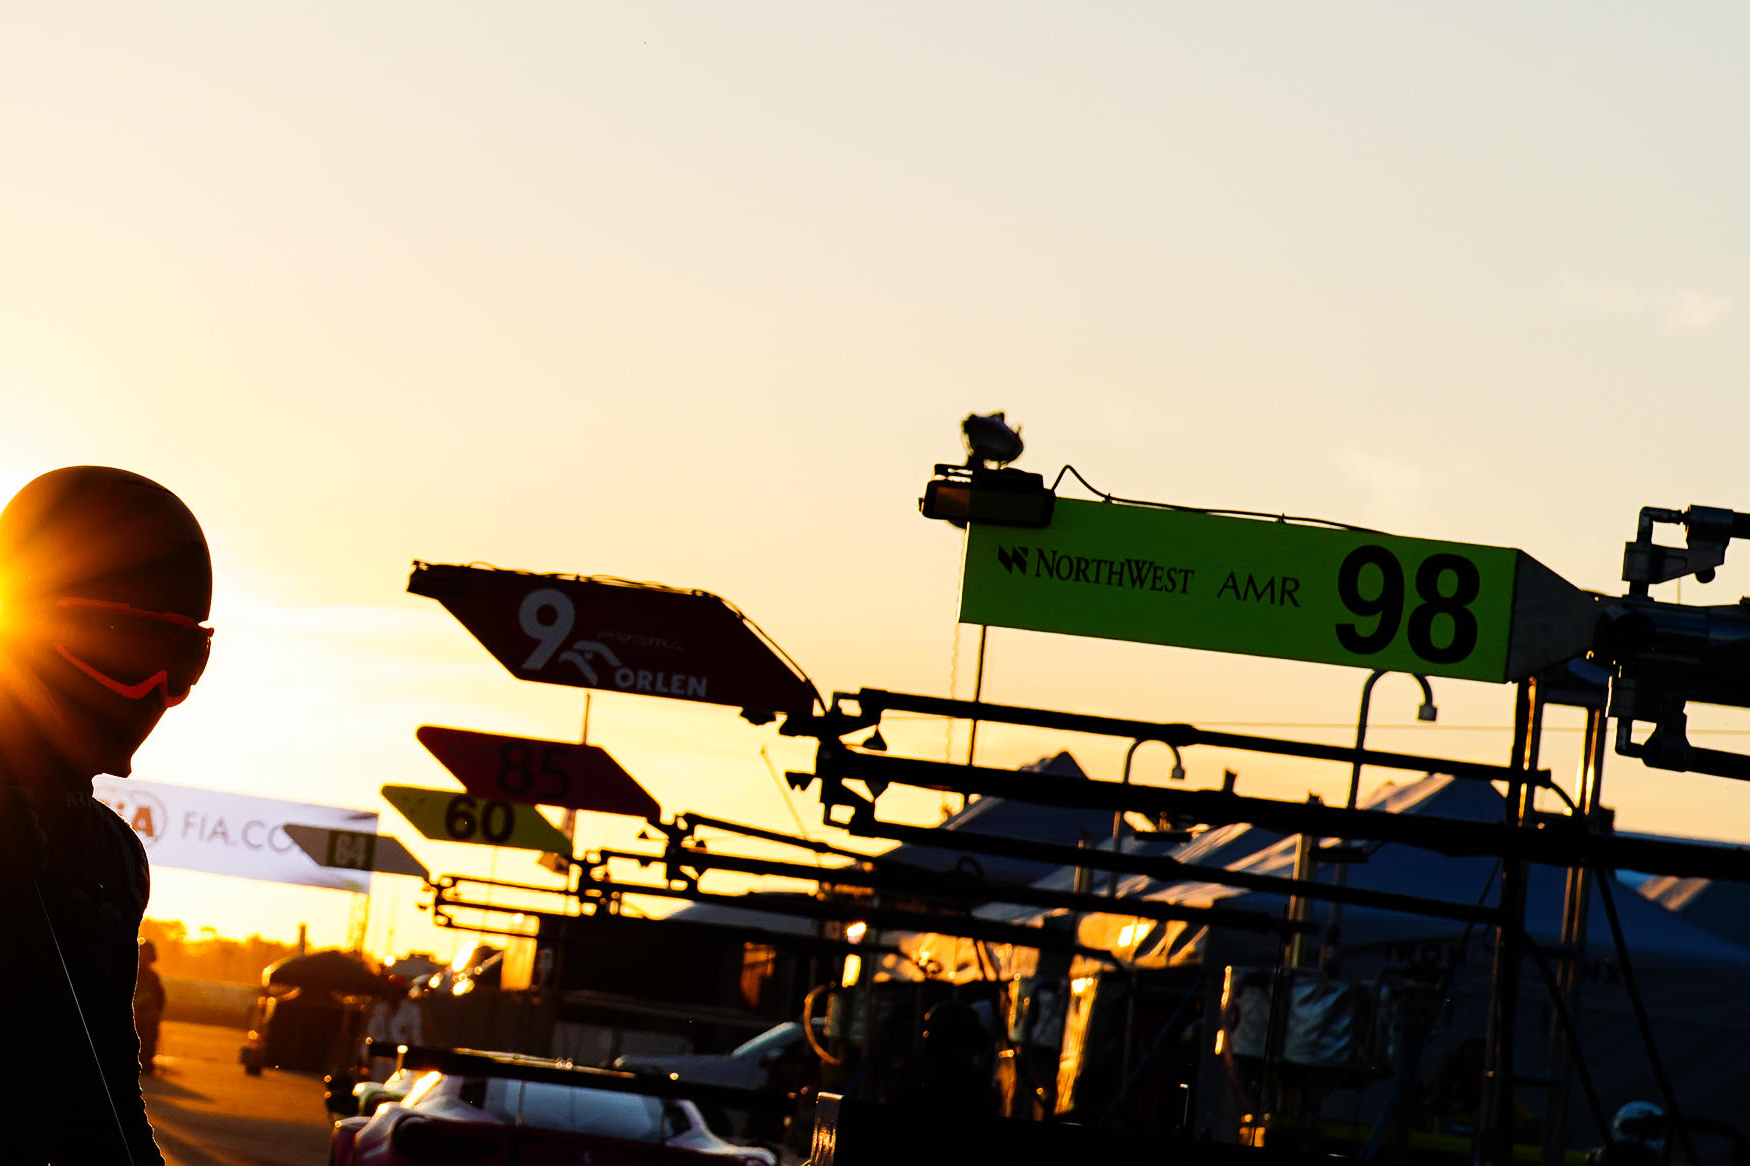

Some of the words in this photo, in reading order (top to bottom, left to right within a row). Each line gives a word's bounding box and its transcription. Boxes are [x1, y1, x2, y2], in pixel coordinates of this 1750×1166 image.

[518, 588, 576, 670] 9
[1216, 570, 1300, 607] AMR
[1335, 544, 1480, 665] 98
[613, 667, 709, 698] ORLEN
[497, 741, 571, 800] 85
[181, 811, 295, 853] FIA.CO
[445, 795, 515, 843] 60
